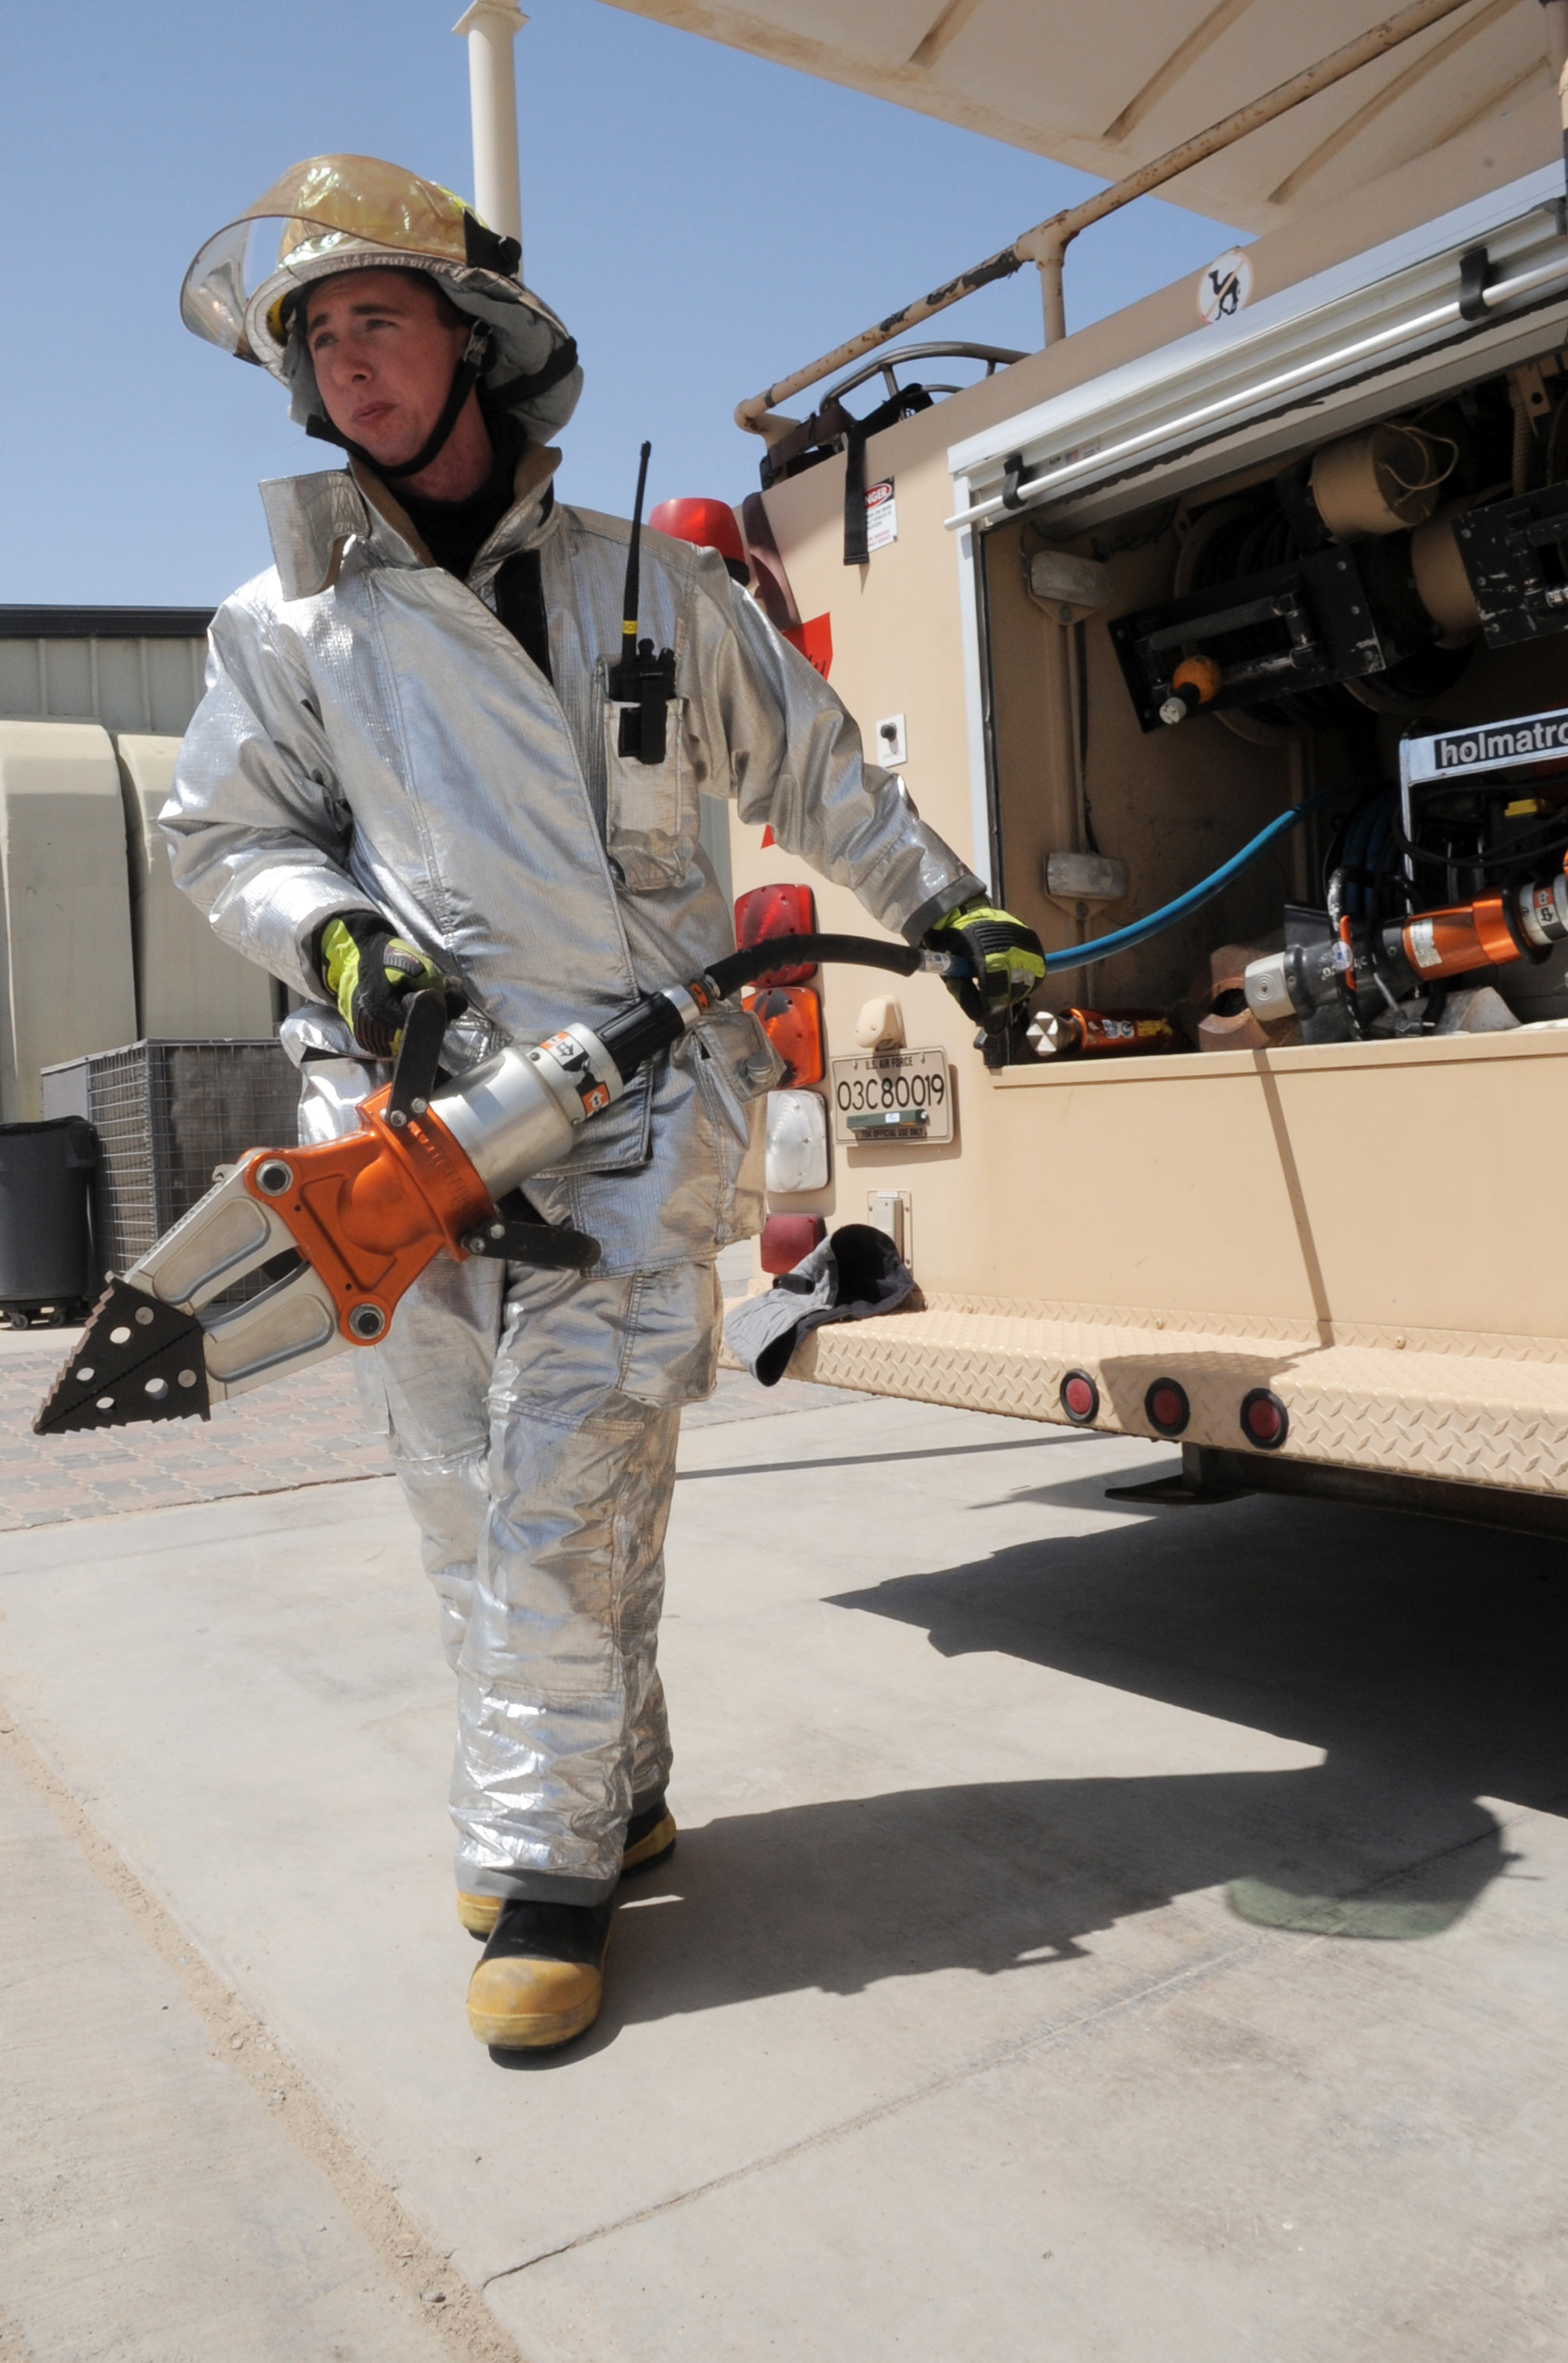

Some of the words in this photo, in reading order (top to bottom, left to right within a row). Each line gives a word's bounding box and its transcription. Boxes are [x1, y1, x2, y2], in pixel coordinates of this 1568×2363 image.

[865, 486, 888, 504] NGER
[865, 1061, 877, 1070] U.S.
[879, 1058, 890, 1069] AIR
[892, 1056, 913, 1068] FORCE
[837, 1073, 945, 1111] 03C80019
[873, 1128, 897, 1137] OFFICIAL
[897, 1128, 909, 1137] USE
[909, 1128, 924, 1137] ONLY
